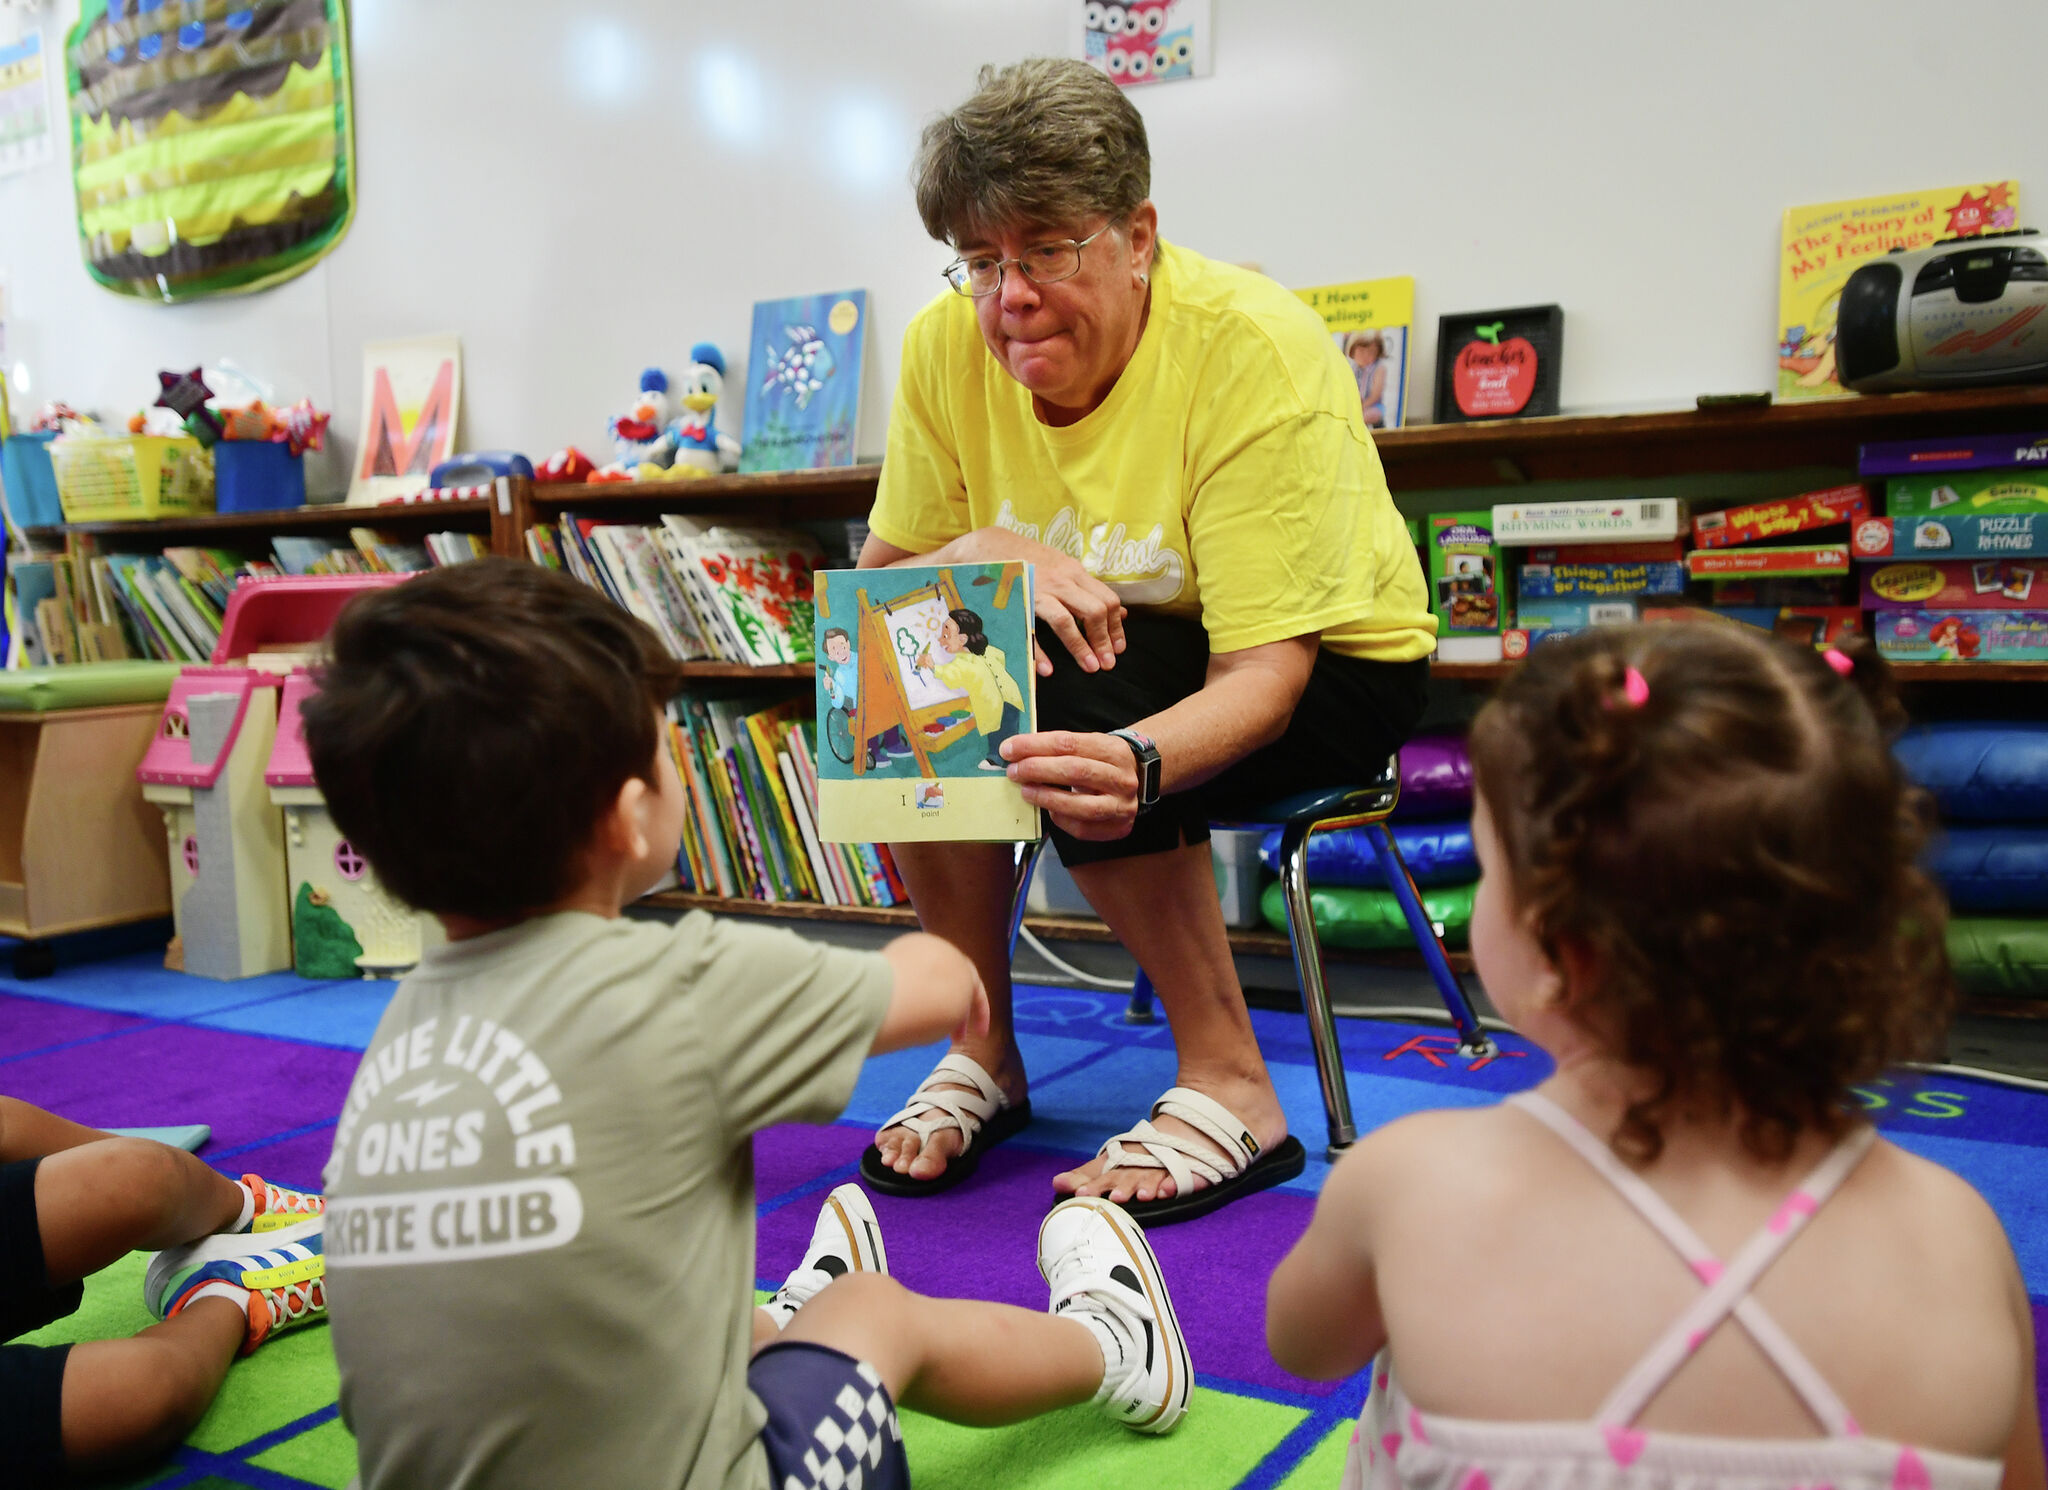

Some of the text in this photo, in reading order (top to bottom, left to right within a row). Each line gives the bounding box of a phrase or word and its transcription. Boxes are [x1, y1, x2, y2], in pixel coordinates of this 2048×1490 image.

[1958, 207, 1980, 219] CD
[1787, 206, 1935, 258] The Story of
[1790, 252, 1827, 281] My
[1836, 230, 1935, 260] Feelings
[1501, 517, 1633, 532] RHYMING WORDS
[1731, 504, 1789, 529] Whose
[1980, 517, 2032, 533] PUZZLE
[1084, 522, 1166, 576] School
[1978, 534, 2034, 549] RHYMES
[1553, 564, 1606, 580] Things
[1612, 565, 1647, 578] that
[1554, 581, 1573, 594] go
[1579, 579, 1648, 594] together
[444, 1014, 576, 1168] LITTLE
[357, 1109, 485, 1176] ONES
[325, 1191, 557, 1257] KATE CLUB
[1123, 1398, 1142, 1415] NIKE
